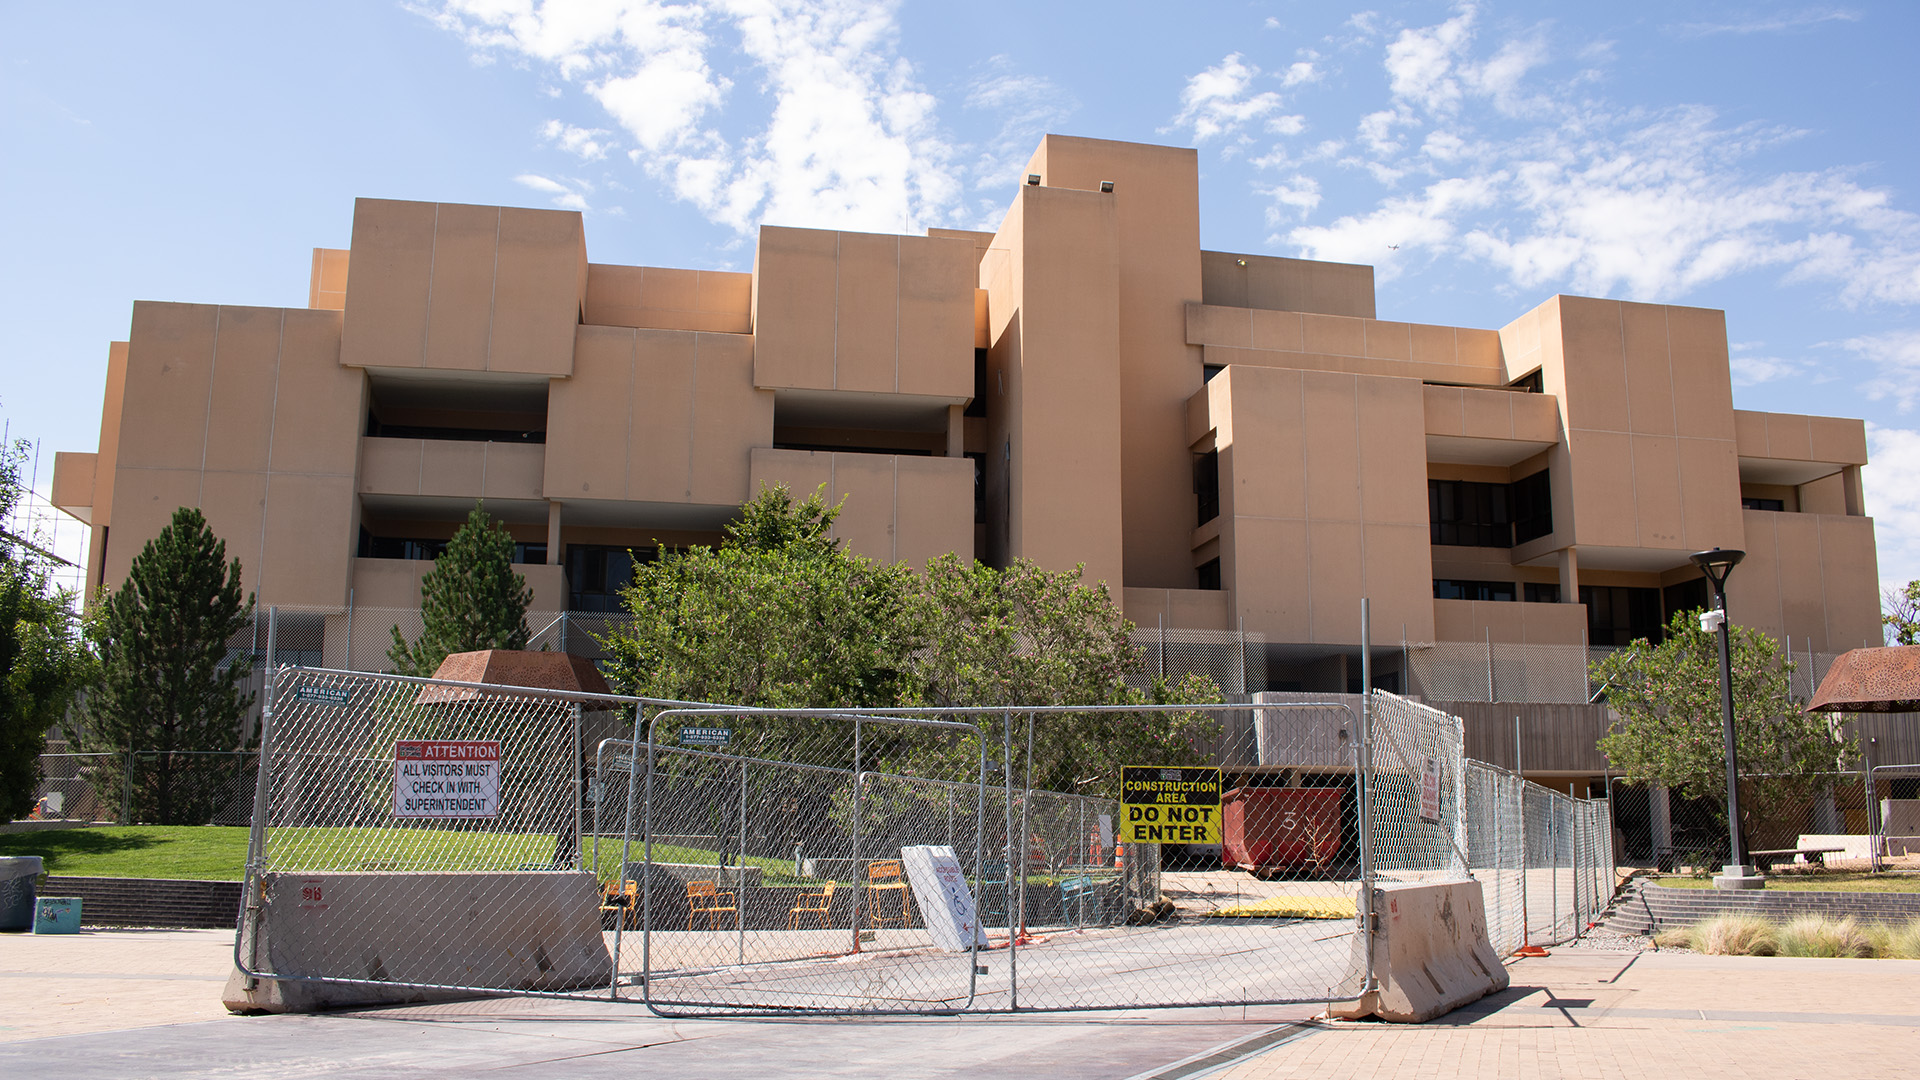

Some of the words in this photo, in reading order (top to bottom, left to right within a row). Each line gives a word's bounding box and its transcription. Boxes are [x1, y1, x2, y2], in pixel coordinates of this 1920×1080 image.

[300, 687, 348, 697] AMERICAN
[425, 745, 496, 758] ATTENTION
[403, 764, 420, 776] ALL
[422, 764, 463, 776] VISITORS
[465, 764, 491, 776] MUST
[412, 781, 444, 793] CHECK
[446, 781, 455, 793] IN
[457, 781, 480, 793] WITH
[1126, 781, 1217, 792] CONSTRUCTION
[1156, 793, 1187, 803] AREA
[405, 798, 487, 811] SUPERINTENDENT
[1129, 806, 1159, 822] DO
[1168, 807, 1213, 823] NOT
[1134, 825, 1208, 841] ENTER
